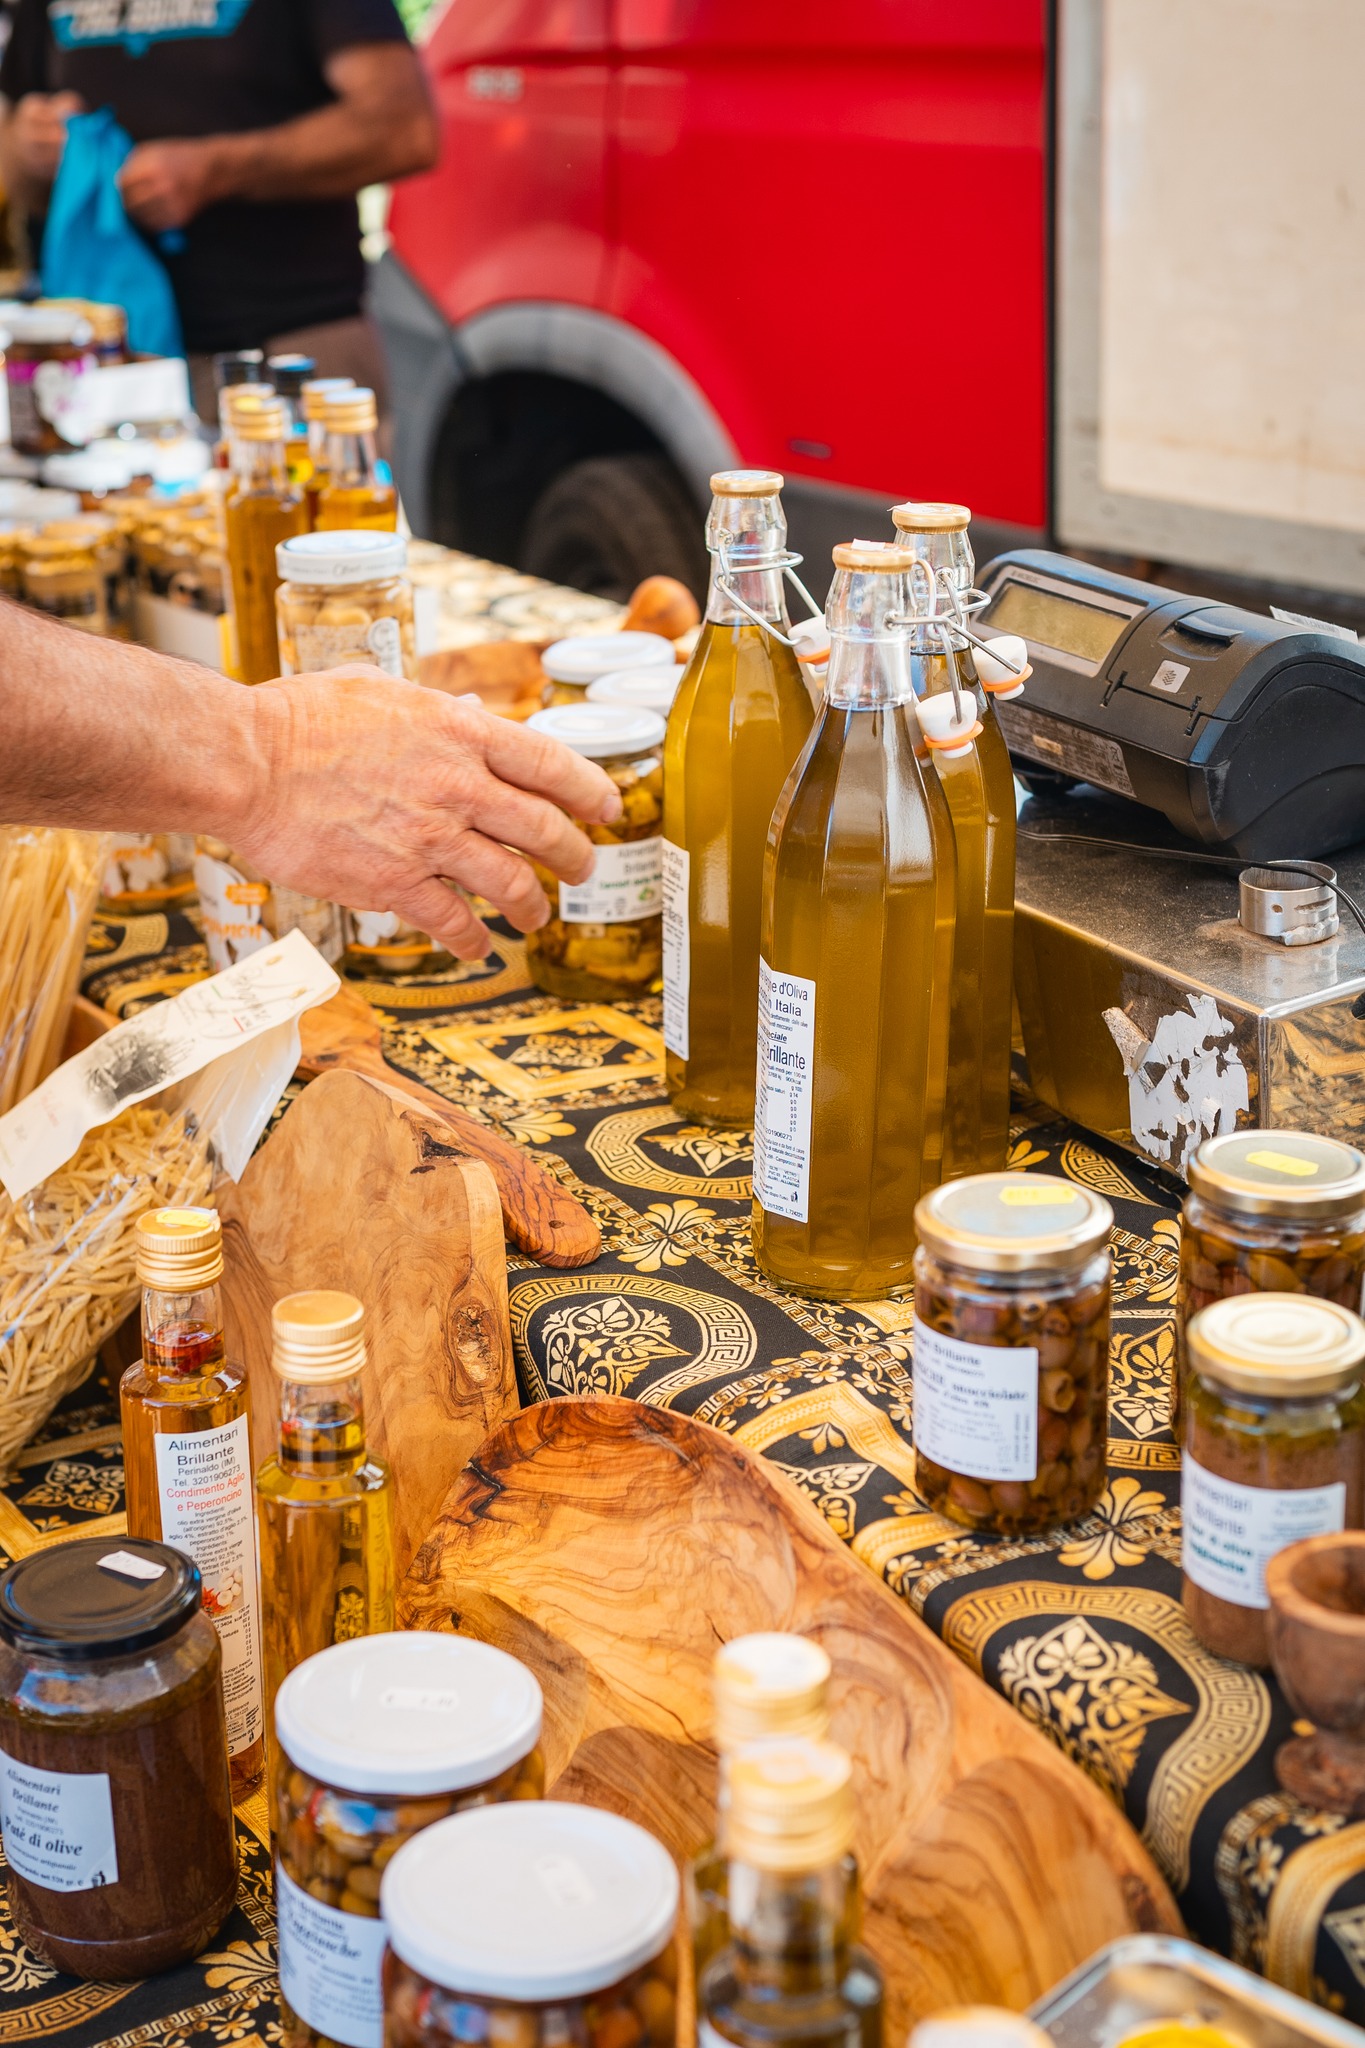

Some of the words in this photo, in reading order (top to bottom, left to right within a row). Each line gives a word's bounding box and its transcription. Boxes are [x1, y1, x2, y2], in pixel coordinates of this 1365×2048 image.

[779, 982, 808, 1001] d'Oliva
[775, 998, 802, 1017] Italia
[168, 1426, 239, 1452] Alimentari
[177, 1446, 234, 1466] Brillante
[178, 1463, 220, 1477] Perinaldo
[221, 1456, 236, 1470] (IM)
[166, 1482, 225, 1499] Condimento
[226, 1472, 246, 1489] Aglio
[172, 1478, 189, 1487] Tel.
[192, 1464, 241, 1487] 3201906273
[187, 1488, 242, 1512] Peperoncino
[206, 1513, 226, 1523] vergine
[190, 1533, 224, 1547] peperoncino
[197, 1529, 219, 1538] estratto
[194, 1551, 213, 1559] d'olive
[214, 1547, 228, 1555] extra
[229, 1540, 243, 1551] vierge
[7, 1768, 60, 1796] Alimentari
[12, 1788, 59, 1813] Brillante
[28, 1833, 41, 1848] di
[44, 1839, 83, 1857] olive
